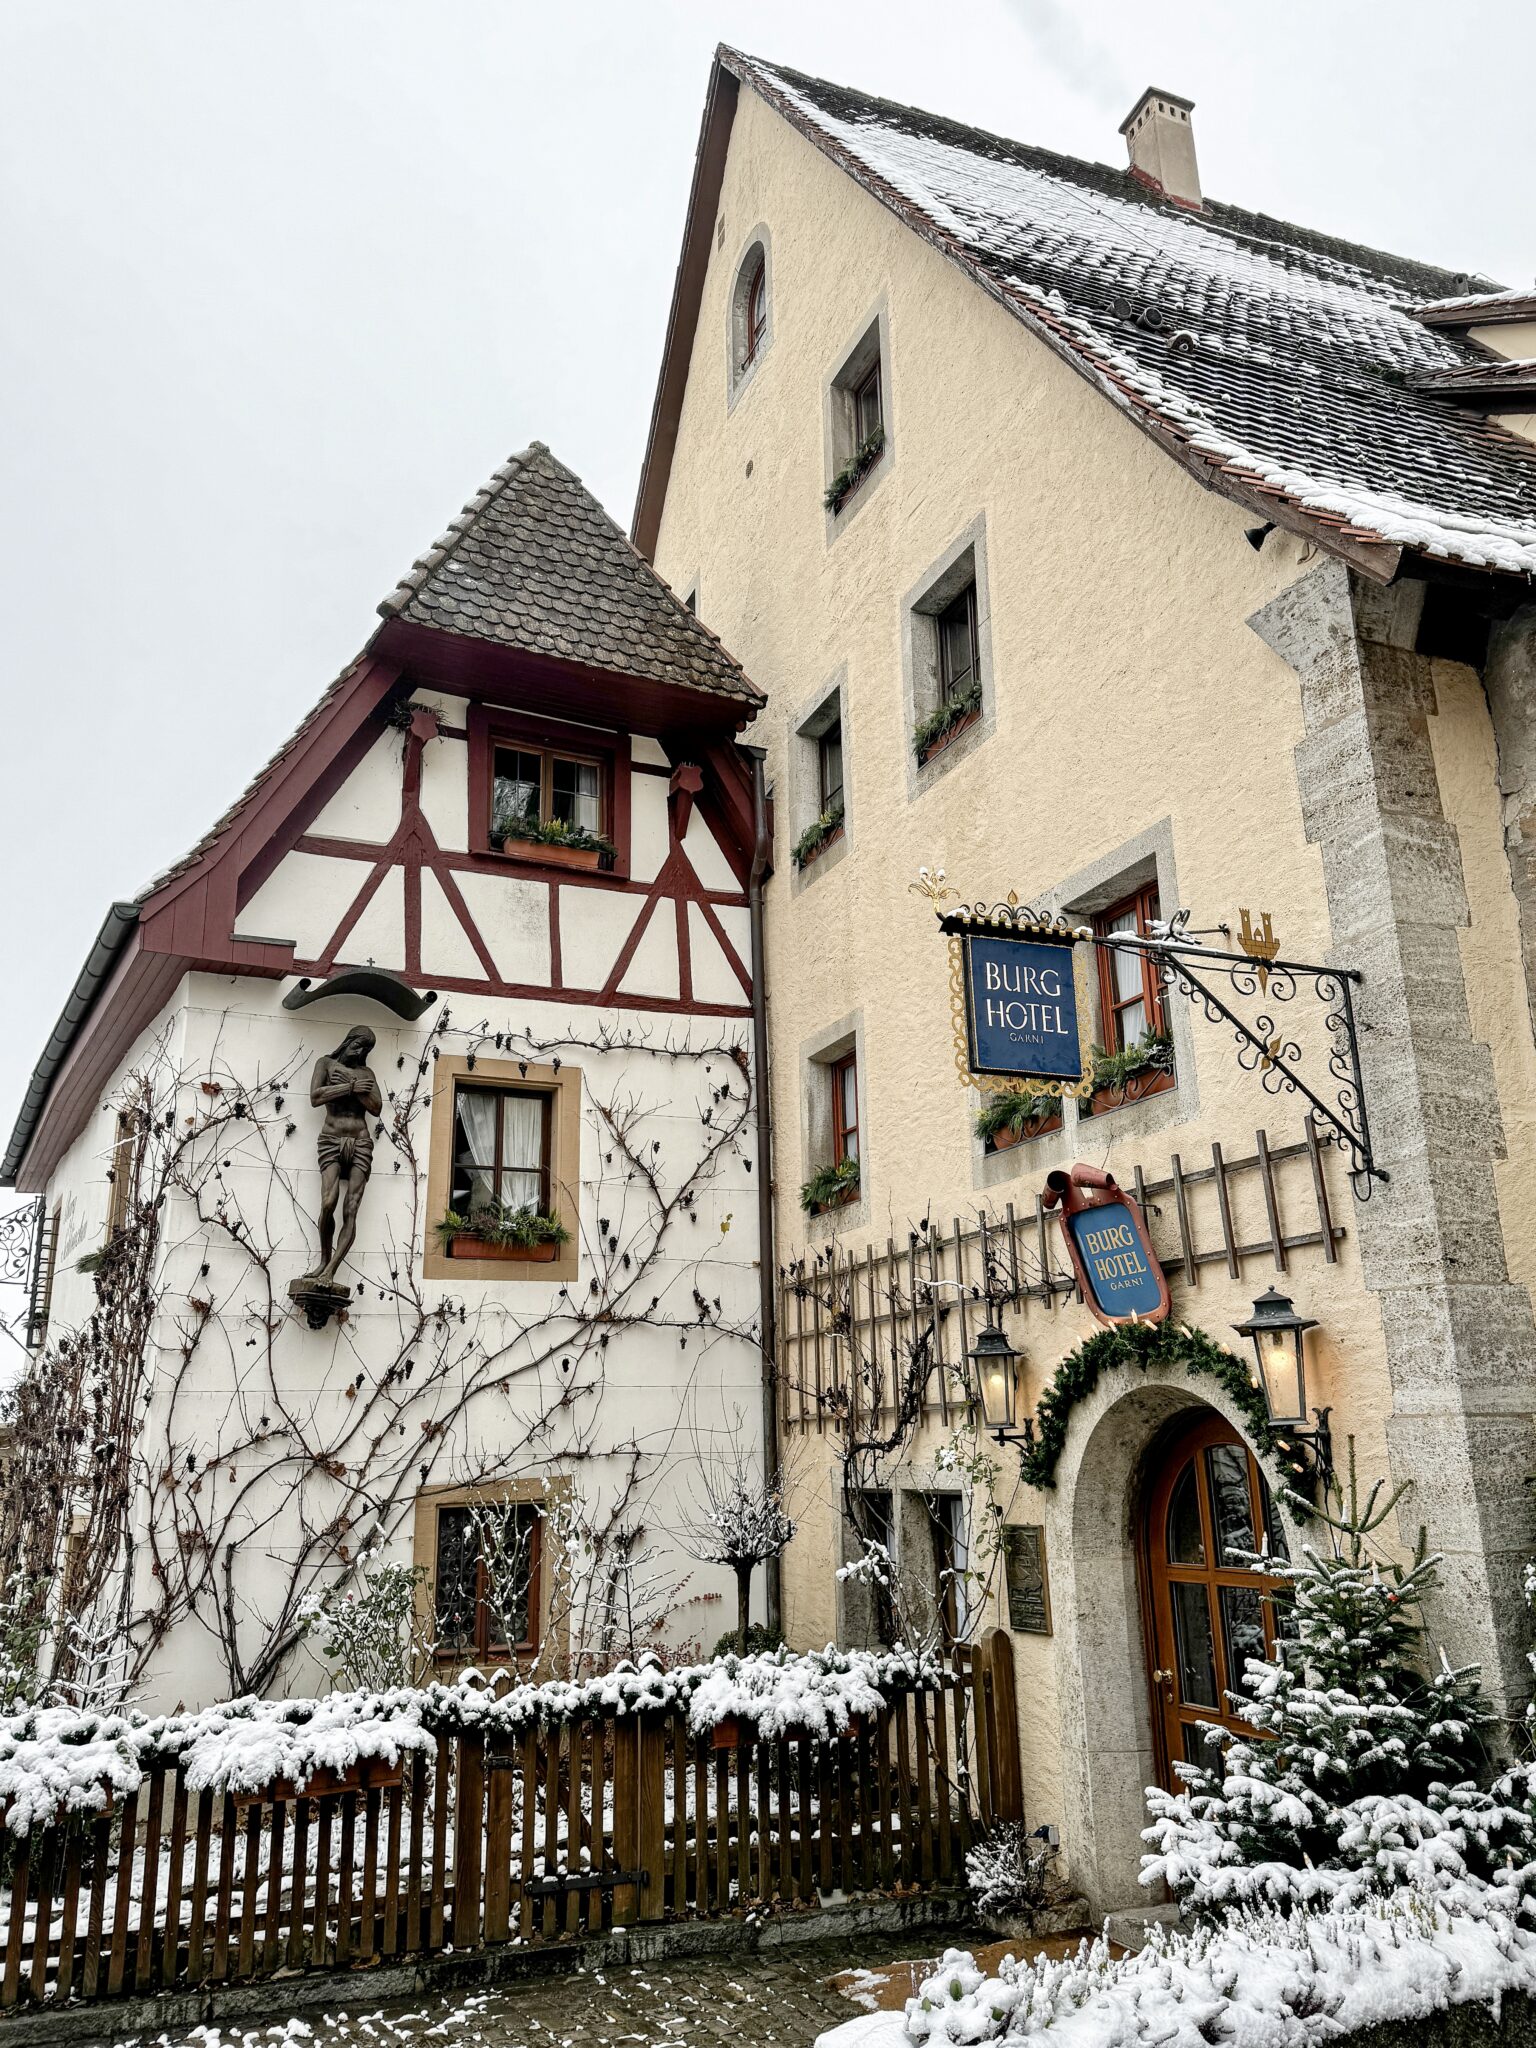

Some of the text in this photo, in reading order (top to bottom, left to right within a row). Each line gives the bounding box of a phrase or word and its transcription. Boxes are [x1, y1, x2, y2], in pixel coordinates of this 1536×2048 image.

[985, 962, 1061, 997] BURG
[986, 998, 1069, 1035] HOTEL
[1009, 1032, 1044, 1045] GARNI
[1085, 1224, 1135, 1255] BURG
[1094, 1251, 1147, 1281] HOTEL
[1110, 1277, 1144, 1291] GARNI
